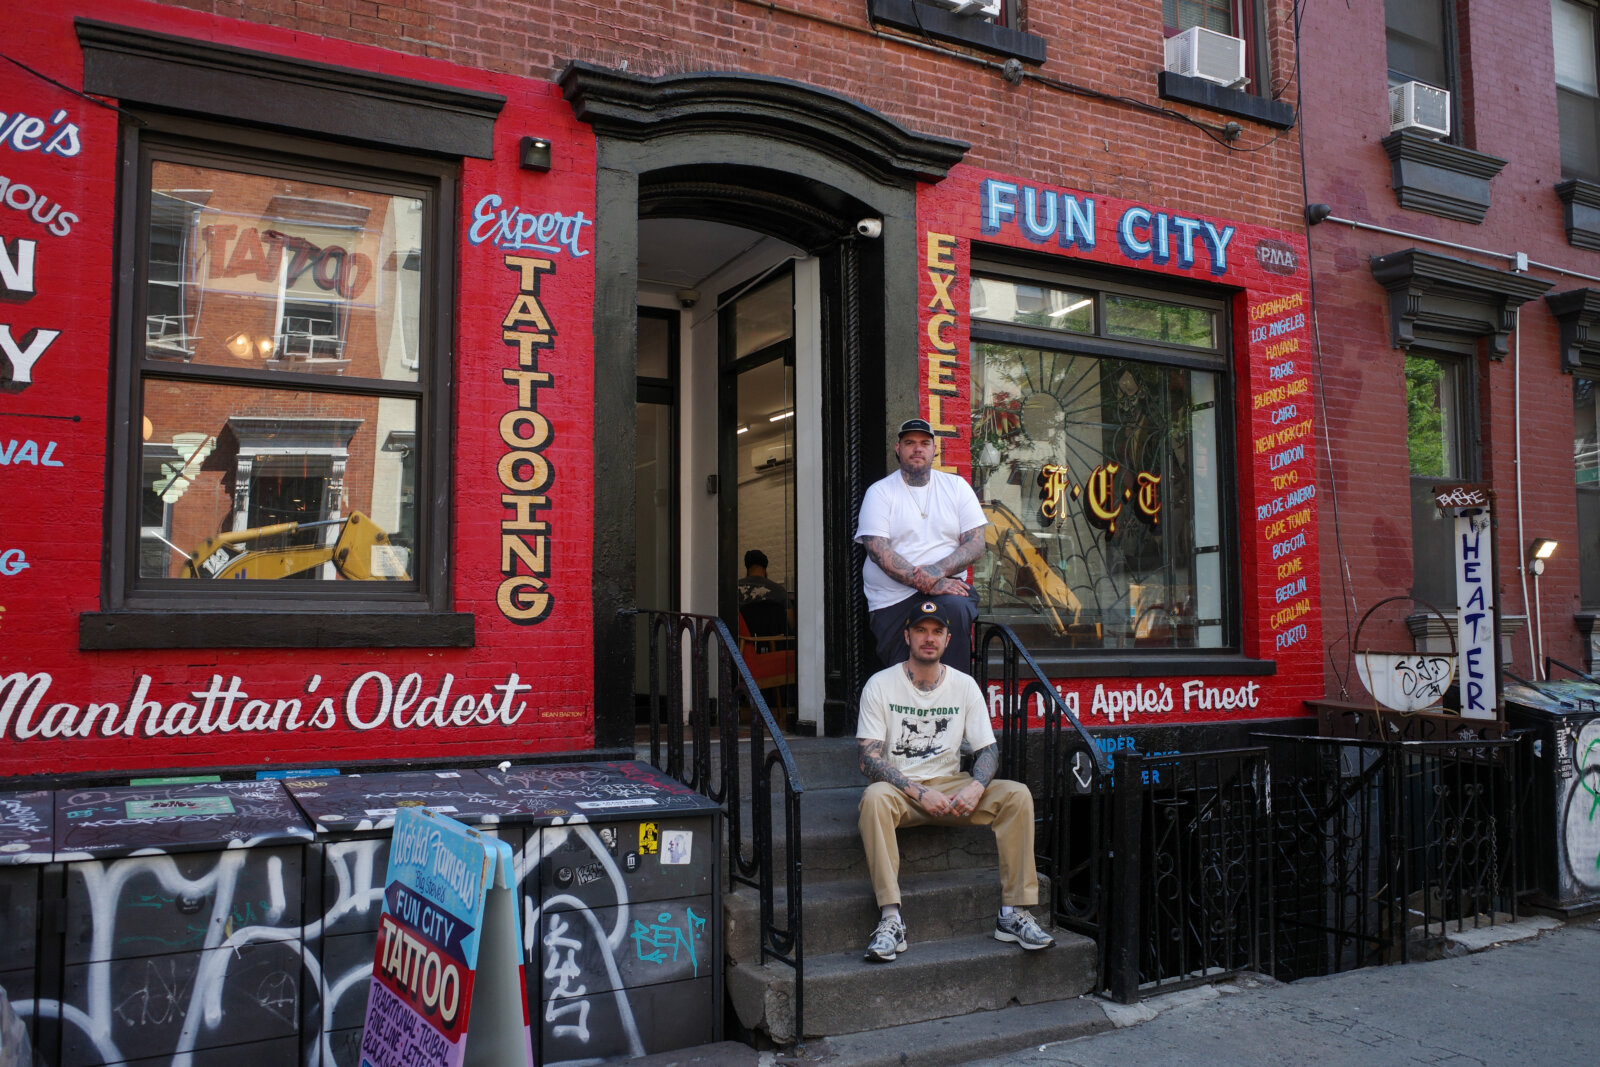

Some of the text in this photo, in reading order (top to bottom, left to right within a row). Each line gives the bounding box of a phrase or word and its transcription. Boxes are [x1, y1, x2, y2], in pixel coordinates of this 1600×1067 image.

[467, 194, 593, 258] Expert
[980, 178, 1235, 276] FUN CITY
[1259, 247, 1295, 268] PMA
[1251, 292, 1303, 320] COPENHAGEN
[1252, 313, 1305, 343] LOS ANGELES
[1266, 338, 1299, 361] HAVANA
[1270, 361, 1294, 381] PARIS
[1254, 377, 1308, 410] BUENOS AIRES
[1272, 404, 1297, 425] CAIRO
[496, 254, 557, 625] TATTOOING
[1255, 419, 1312, 454] NEW YORK CITY
[1270, 444, 1304, 471] LONDON
[1271, 470, 1298, 491] TOKYO
[1257, 484, 1316, 521] RIO DE JANEIRO
[1265, 508, 1311, 540] CAPE TOWN
[1278, 557, 1302, 580] ROME
[1275, 576, 1307, 604] BERLIN
[1271, 598, 1310, 630] CATALINA
[1459, 507, 1486, 711] THEATER
[1276, 624, 1307, 650] PORTO
[0, 670, 532, 740] Manhattan's Oldest
[889, 703, 960, 717] YOUTH OF TODAY
[1091, 682, 1174, 723] Apple's
[1183, 679, 1261, 713] Finest
[1096, 737, 1136, 753] NDER
[394, 819, 476, 911] World Famous
[396, 889, 455, 948] FUN CITY
[381, 917, 460, 1025] TATTOO
[367, 1007, 386, 1037] FINE
[384, 1022, 402, 1052] LINE
[373, 982, 450, 1066] TRADITIONAL TRIBAL
